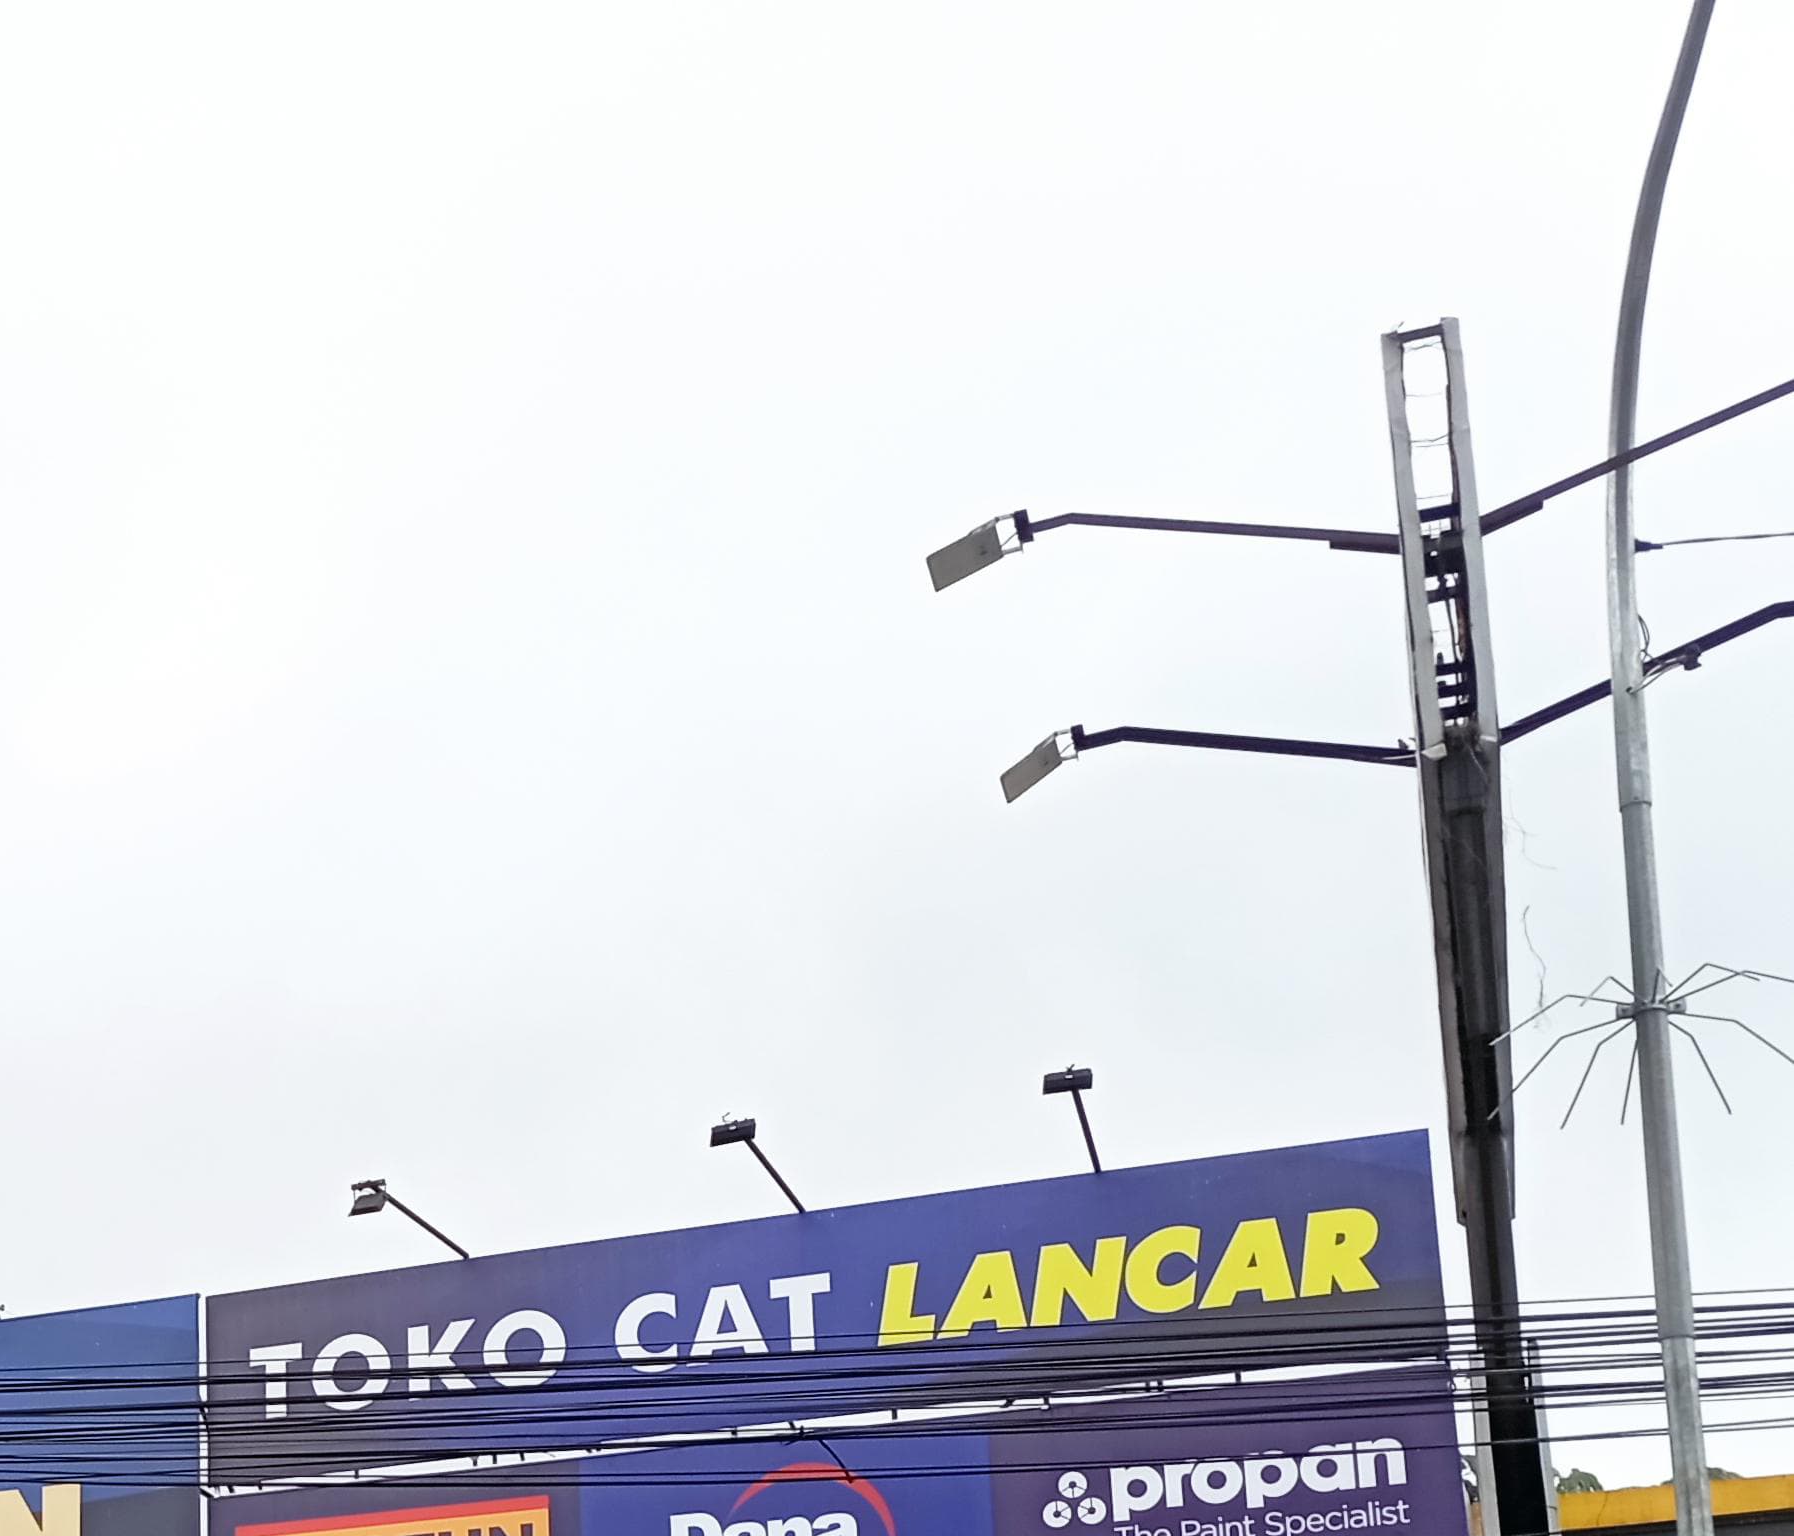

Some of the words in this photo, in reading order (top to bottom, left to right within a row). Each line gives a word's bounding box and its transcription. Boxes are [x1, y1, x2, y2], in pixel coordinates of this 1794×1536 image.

[248, 1308, 569, 1420] TOKO
[614, 1271, 833, 1374] CAT
[877, 1206, 1381, 1348] LANCAR
[1108, 1437, 1407, 1523] propan
